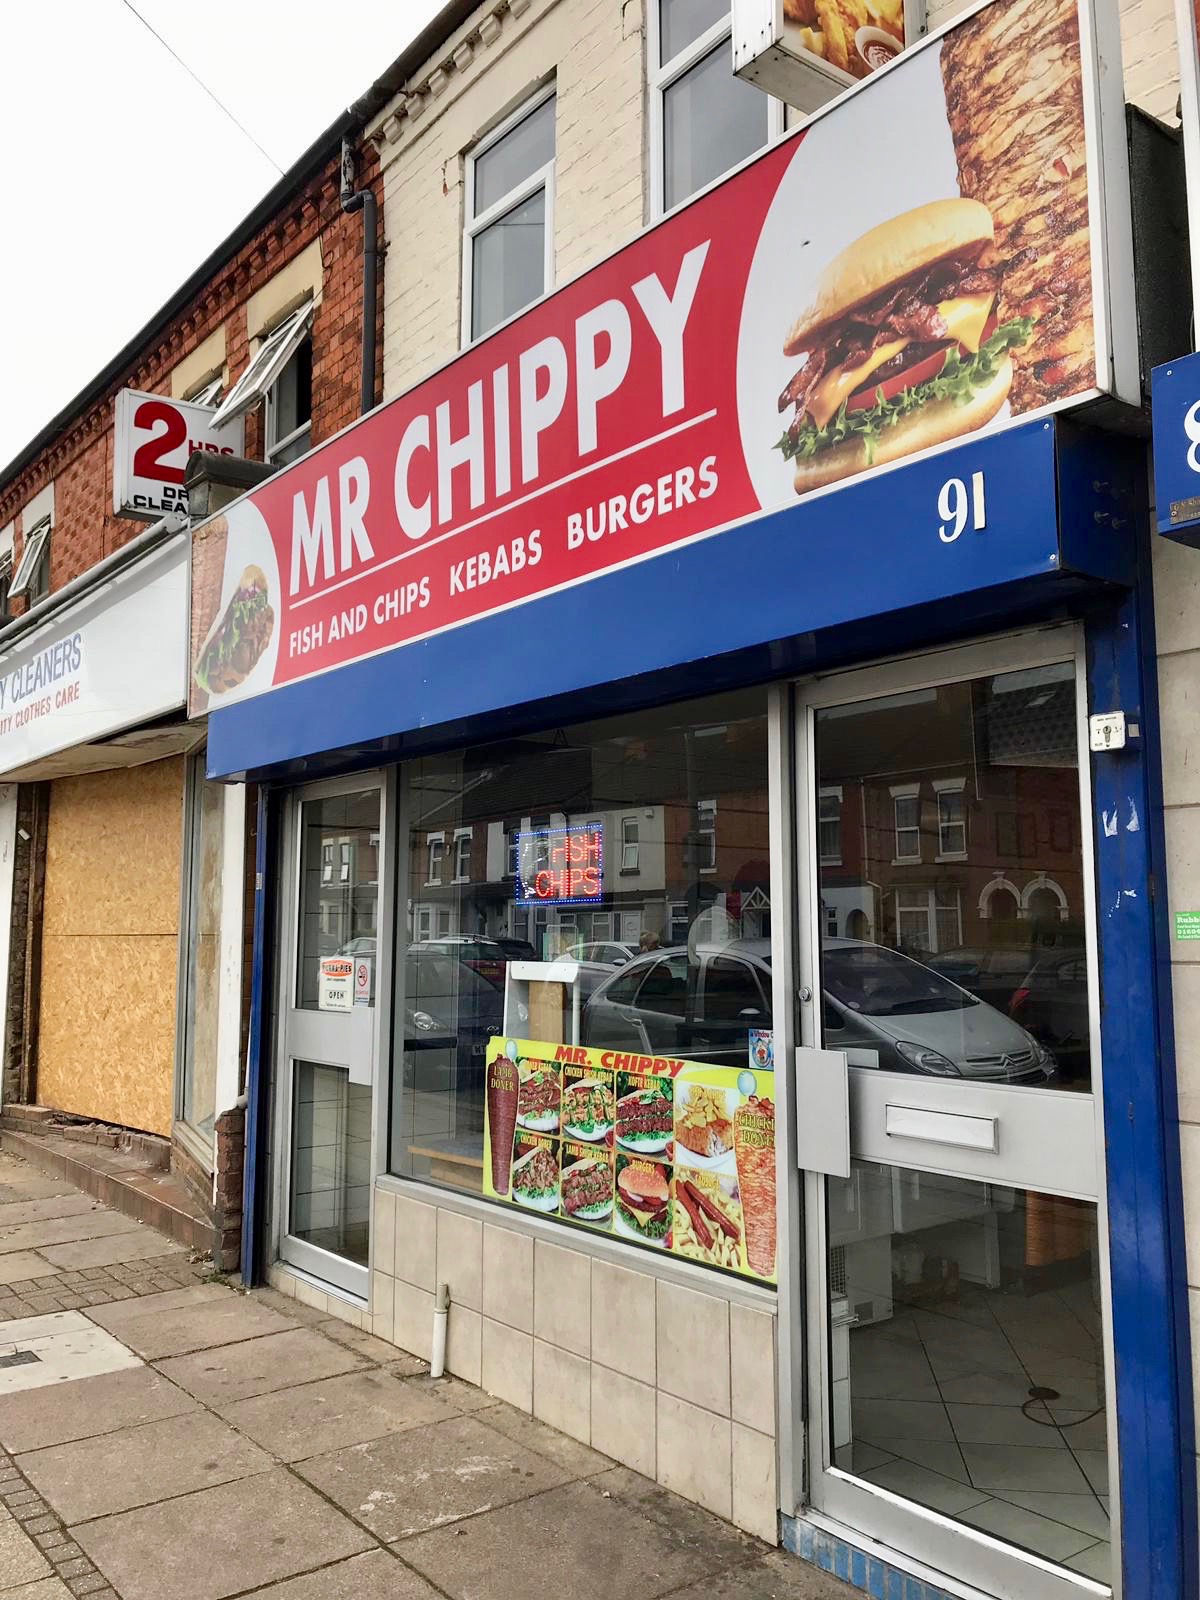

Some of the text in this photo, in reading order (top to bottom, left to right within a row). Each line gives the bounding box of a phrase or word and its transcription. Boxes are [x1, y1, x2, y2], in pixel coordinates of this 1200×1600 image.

[133, 401, 187, 485] 2
[290, 239, 711, 597] MR CHIPPY
[937, 471, 986, 543] 91
[289, 455, 719, 658] FISH AND CHIPS KEBABS BURGERS
[12, 632, 81, 703] CLEANERS
[15, 696, 51, 728] CLOTHES
[55, 681, 80, 709] CARE
[535, 866, 598, 897] CHIPS
[328, 991, 345, 999] OPEN
[491, 1078, 514, 1091] DONER
[555, 1046, 685, 1078] MR. CHIPPY
